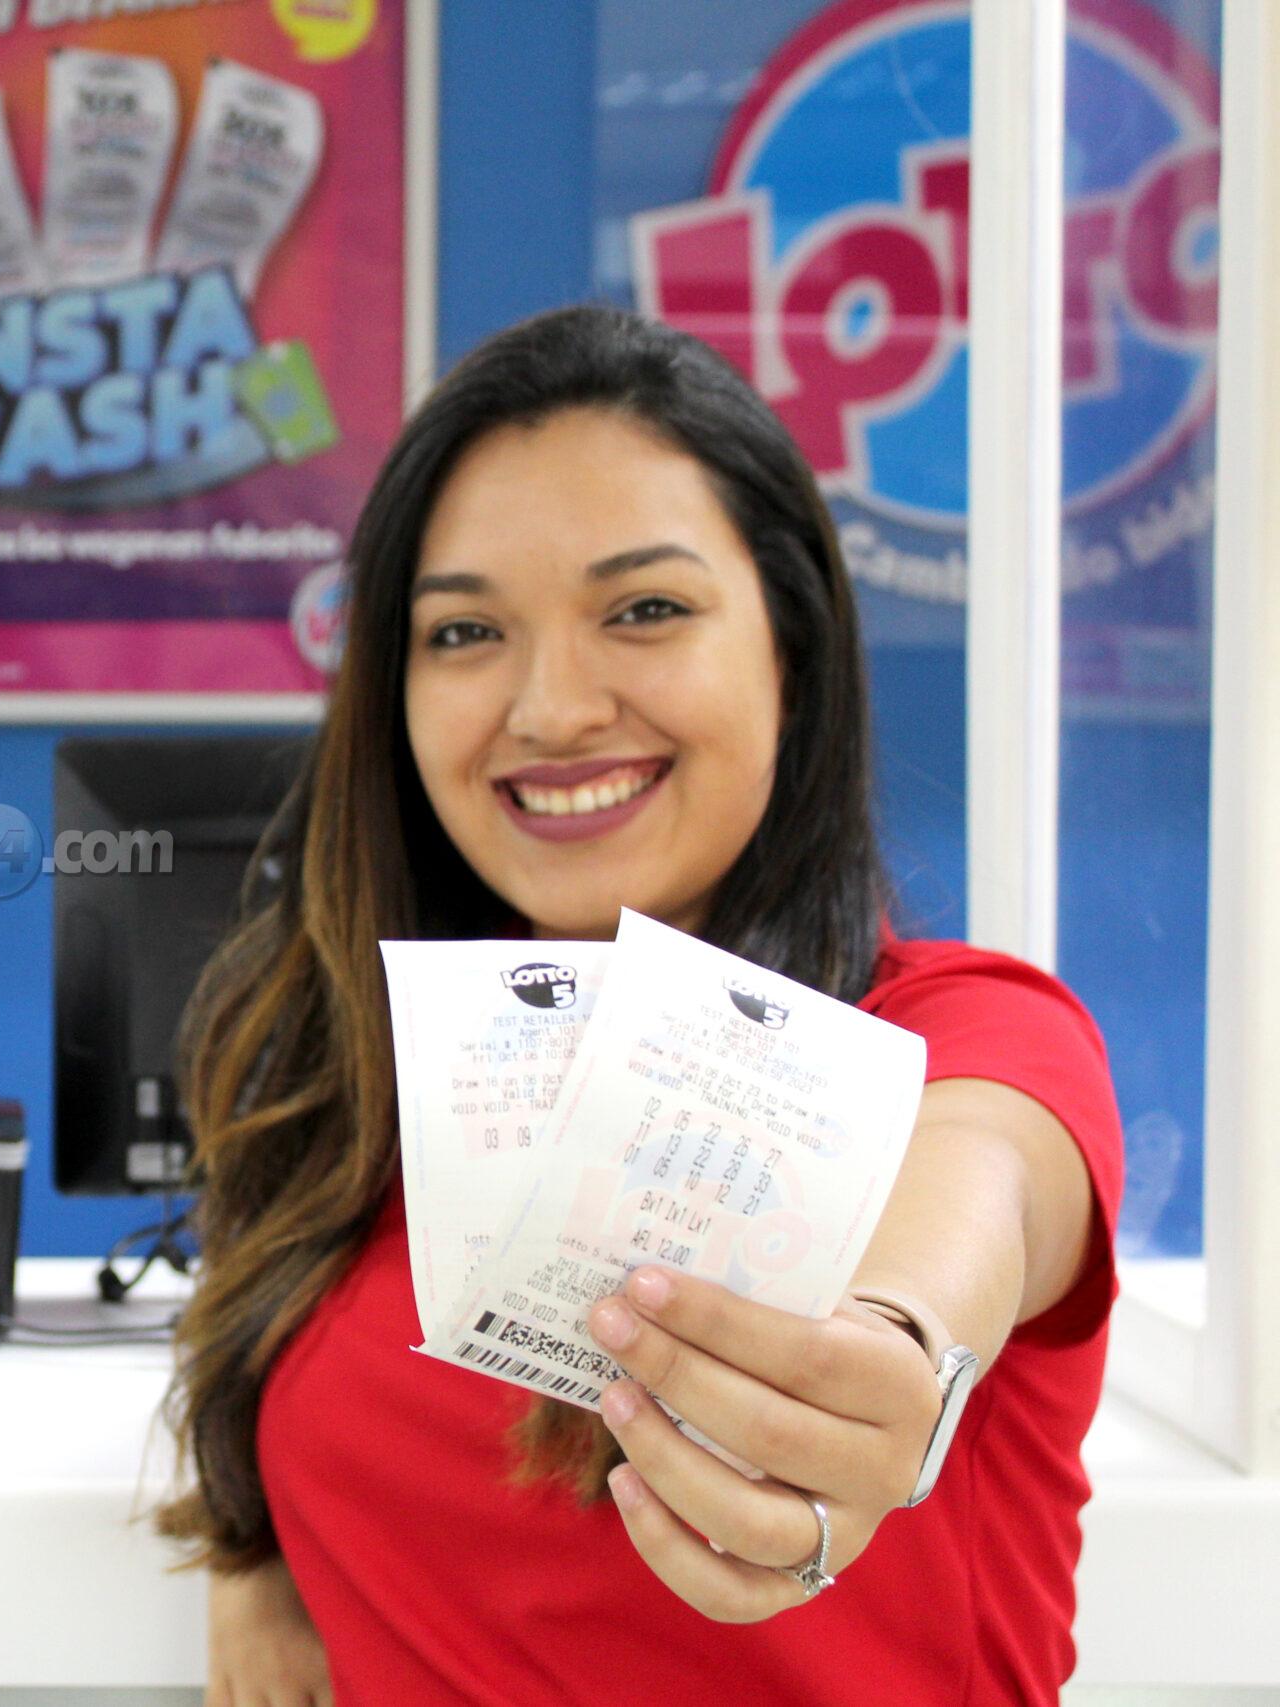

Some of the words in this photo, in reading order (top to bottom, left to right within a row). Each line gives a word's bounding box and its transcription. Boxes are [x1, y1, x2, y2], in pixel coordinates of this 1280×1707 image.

[500, 966, 577, 989] LOTTO
[552, 984, 577, 1010] 5
[493, 1016, 518, 1027] TEST
[523, 1014, 576, 1026] RETAILER
[762, 1005, 787, 1030] 5
[728, 1017, 777, 1044] RETAILER
[498, 1051, 518, 1062] Oct
[452, 1078, 479, 1089] Draw
[504, 1077, 518, 1087] on
[542, 1073, 563, 1085] Oct
[638, 1038, 664, 1056] Draw
[722, 1073, 743, 1091] Oct
[765, 1092, 779, 1105] to
[781, 1098, 809, 1118] Draw
[502, 1087, 535, 1100] Valid
[627, 1059, 654, 1079] VOID
[656, 1070, 684, 1091] VOID
[700, 1089, 749, 1120] TRAINING
[765, 1118, 792, 1137] VOID
[796, 1131, 822, 1150] VOID
[680, 1070, 712, 1090] Valid
[718, 1084, 734, 1098] for
[750, 1098, 777, 1117] Draw
[451, 1103, 477, 1115] VOID
[483, 1102, 510, 1114] VOID
[484, 1128, 499, 1149] 03
[517, 1126, 532, 1147] 09
[644, 1096, 662, 1119] 02
[703, 1121, 722, 1145] 22
[733, 1134, 751, 1158] 26
[763, 1148, 783, 1169] 27
[636, 1120, 650, 1142] 11
[666, 1133, 682, 1156] 13
[692, 1146, 712, 1169] 22
[753, 1171, 772, 1194] 33
[624, 1143, 641, 1166] 01
[684, 1169, 701, 1191] 10
[713, 1183, 731, 1205] 12
[742, 1194, 760, 1217] 21
[556, 1233, 588, 1252] Lotto
[656, 1238, 691, 1266] 12.00
[557, 1256, 580, 1273] THIS
[501, 1289, 530, 1312] VOID
[531, 1301, 559, 1324] VOID
